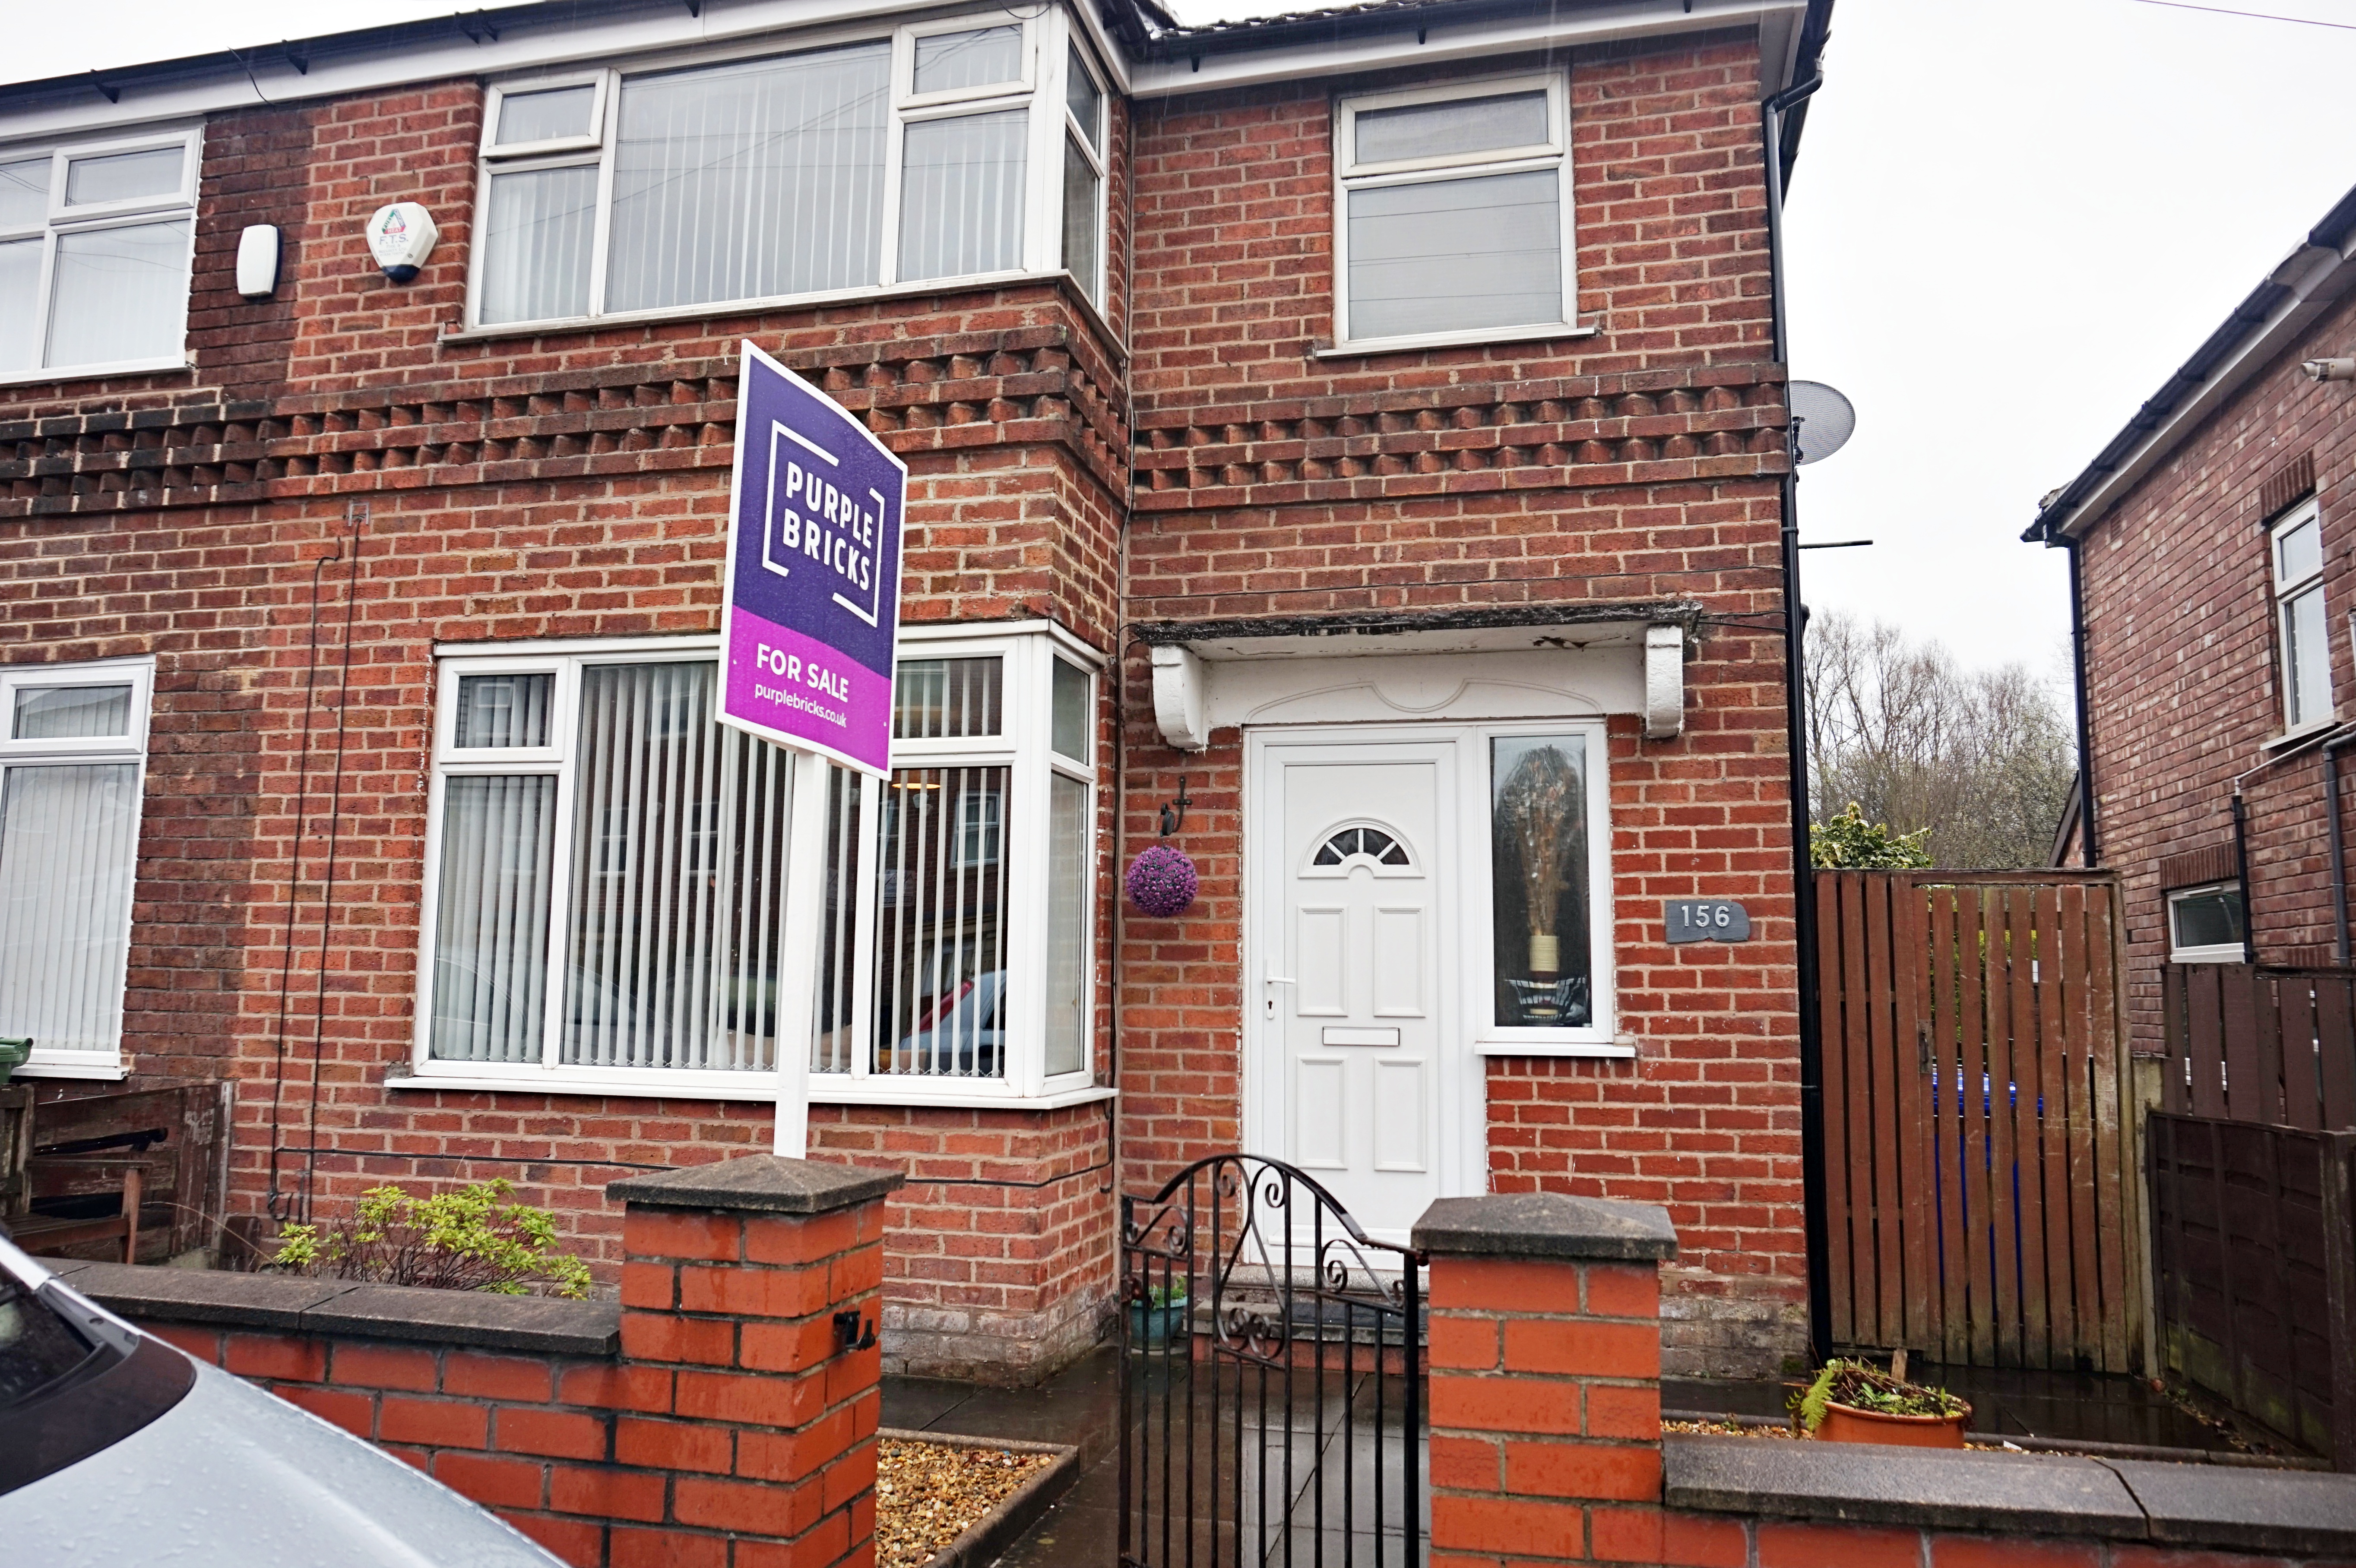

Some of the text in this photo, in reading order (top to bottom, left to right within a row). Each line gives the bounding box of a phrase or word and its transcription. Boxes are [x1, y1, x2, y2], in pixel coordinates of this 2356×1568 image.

[379, 234, 408, 245] F.T.S.
[786, 461, 873, 549] PURPLE
[783, 508, 870, 591] BRICKS
[757, 643, 849, 703] FOR SALE
[755, 683, 847, 728] purplebricks.co.uk
[1681, 905, 1730, 927] 156
